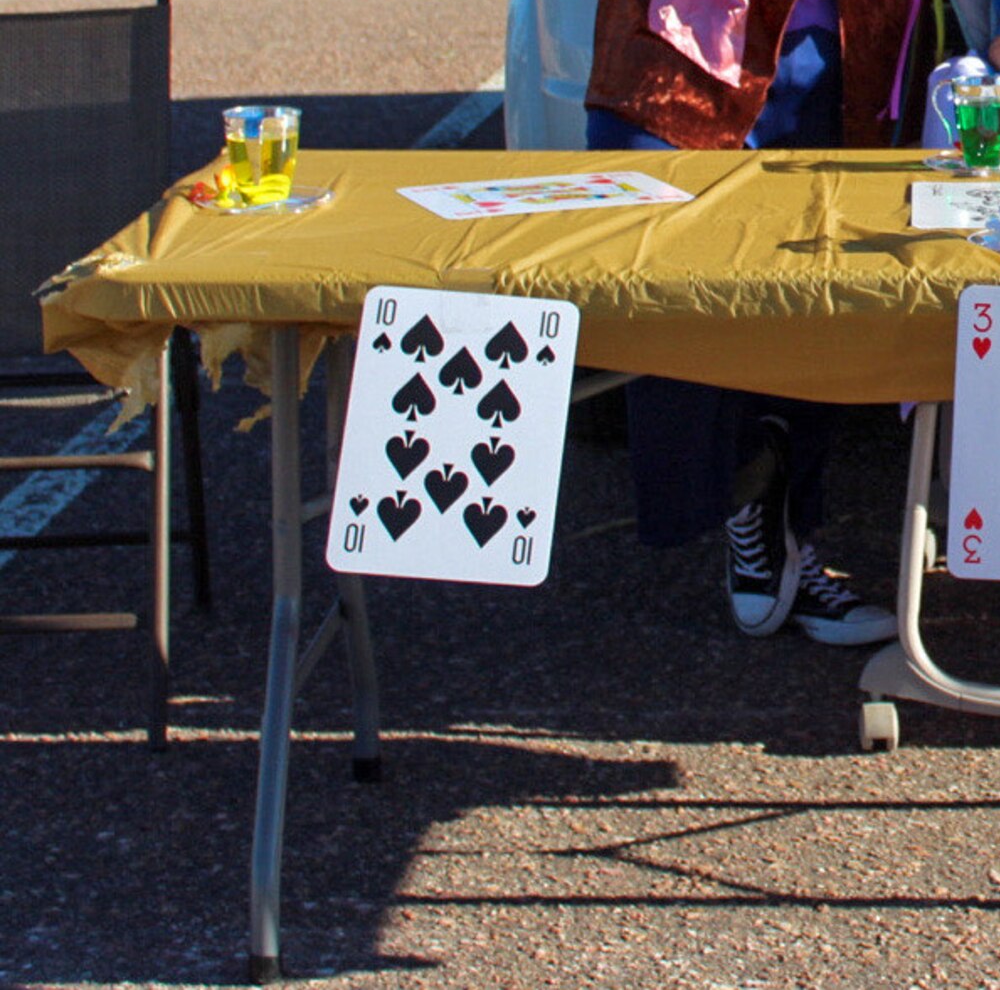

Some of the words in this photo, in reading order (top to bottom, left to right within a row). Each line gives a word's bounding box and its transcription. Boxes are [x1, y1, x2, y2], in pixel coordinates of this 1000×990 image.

[376, 298, 397, 326] 10
[539, 311, 560, 338] 10
[973, 303, 993, 333] 3
